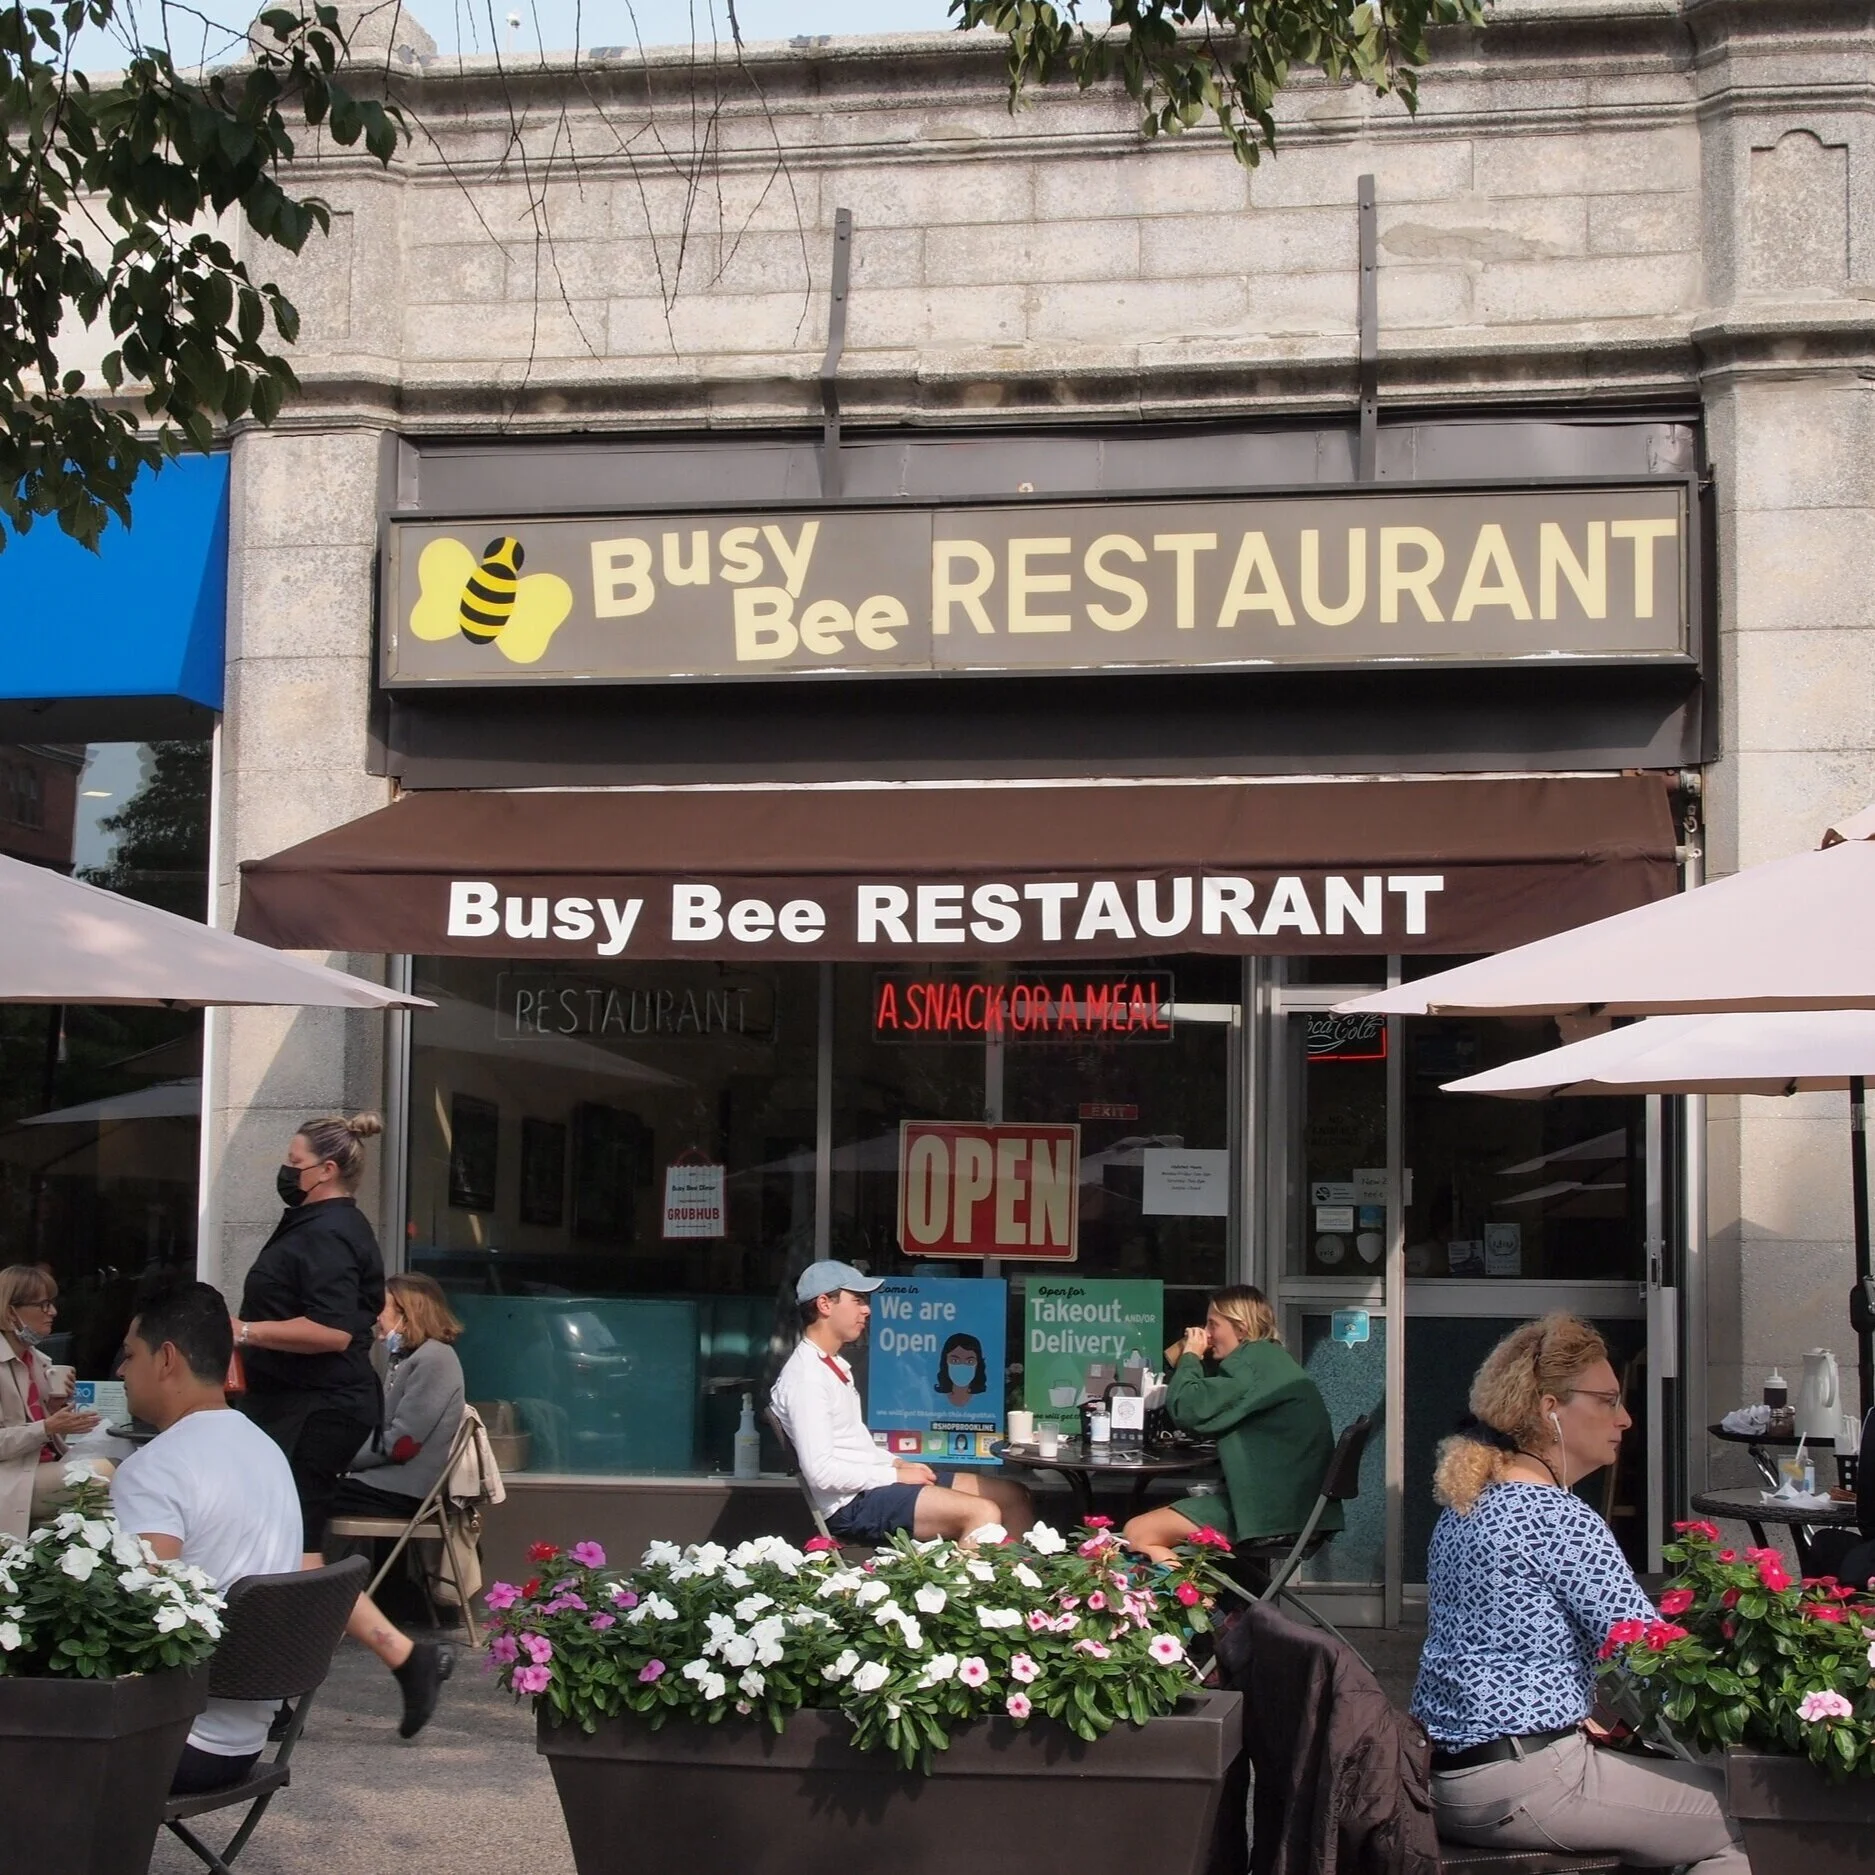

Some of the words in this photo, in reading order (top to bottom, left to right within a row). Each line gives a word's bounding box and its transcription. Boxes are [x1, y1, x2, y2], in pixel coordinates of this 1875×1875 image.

[590, 521, 820, 619] Busy
[734, 587, 910, 662] Bee
[932, 518, 1678, 635] RESTAURANT
[446, 880, 645, 956] Busy
[671, 882, 827, 943] Bee
[857, 874, 1446, 944] RESTAURANT
[515, 988, 752, 1034] RESTAURANT
[877, 982, 899, 1029] A
[904, 983, 1005, 1033] SNACK
[1010, 984, 1049, 1032] OR
[1058, 982, 1079, 1031] A
[1086, 981, 1170, 1031] MEAL
[1092, 1106, 1127, 1118] EXIT
[907, 1134, 1072, 1246] OPEN
[667, 1207, 720, 1220] GRUBHUB
[1038, 1286, 1066, 1299] Open
[1067, 1286, 1086, 1298] for
[880, 1298, 913, 1320] We
[919, 1301, 956, 1321] are
[1030, 1298, 1122, 1323] Takeout
[879, 1327, 937, 1356] Open
[1031, 1329, 1126, 1359] Delivery
